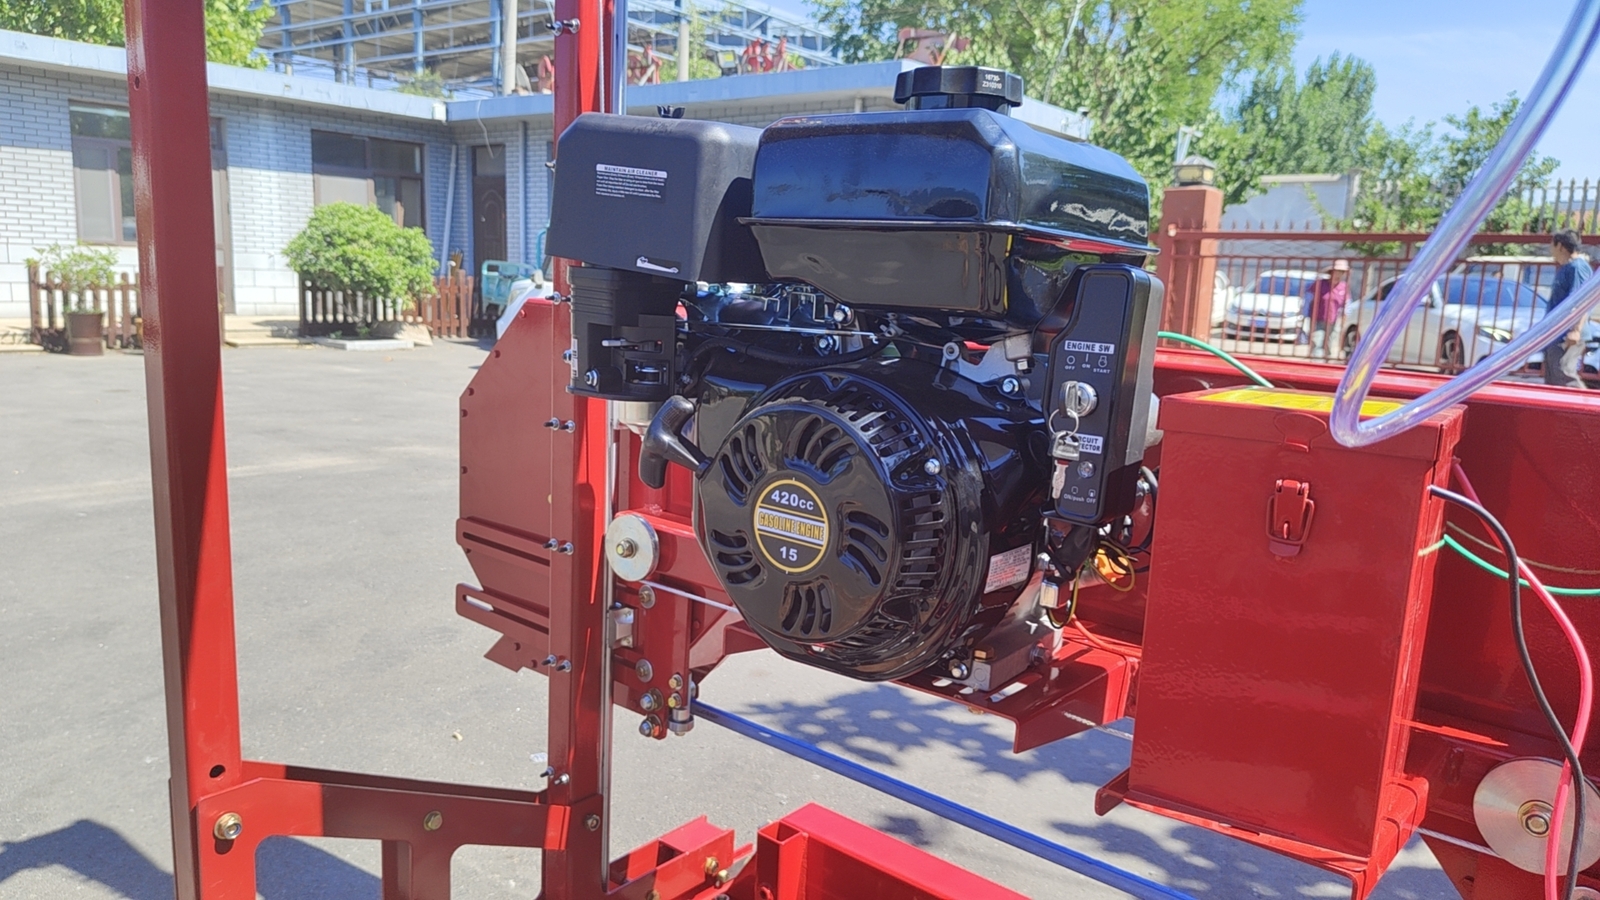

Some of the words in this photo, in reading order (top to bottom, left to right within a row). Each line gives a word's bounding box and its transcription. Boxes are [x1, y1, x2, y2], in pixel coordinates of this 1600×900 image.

[1067, 341, 1096, 352] ENGINE
[1079, 435, 1099, 444] RCUIT
[1080, 444, 1100, 452] ECTOR
[771, 489, 814, 511] 420cc
[759, 511, 796, 533] GASOLINE
[796, 521, 825, 541] ENGINE
[780, 546, 798, 561] 15
